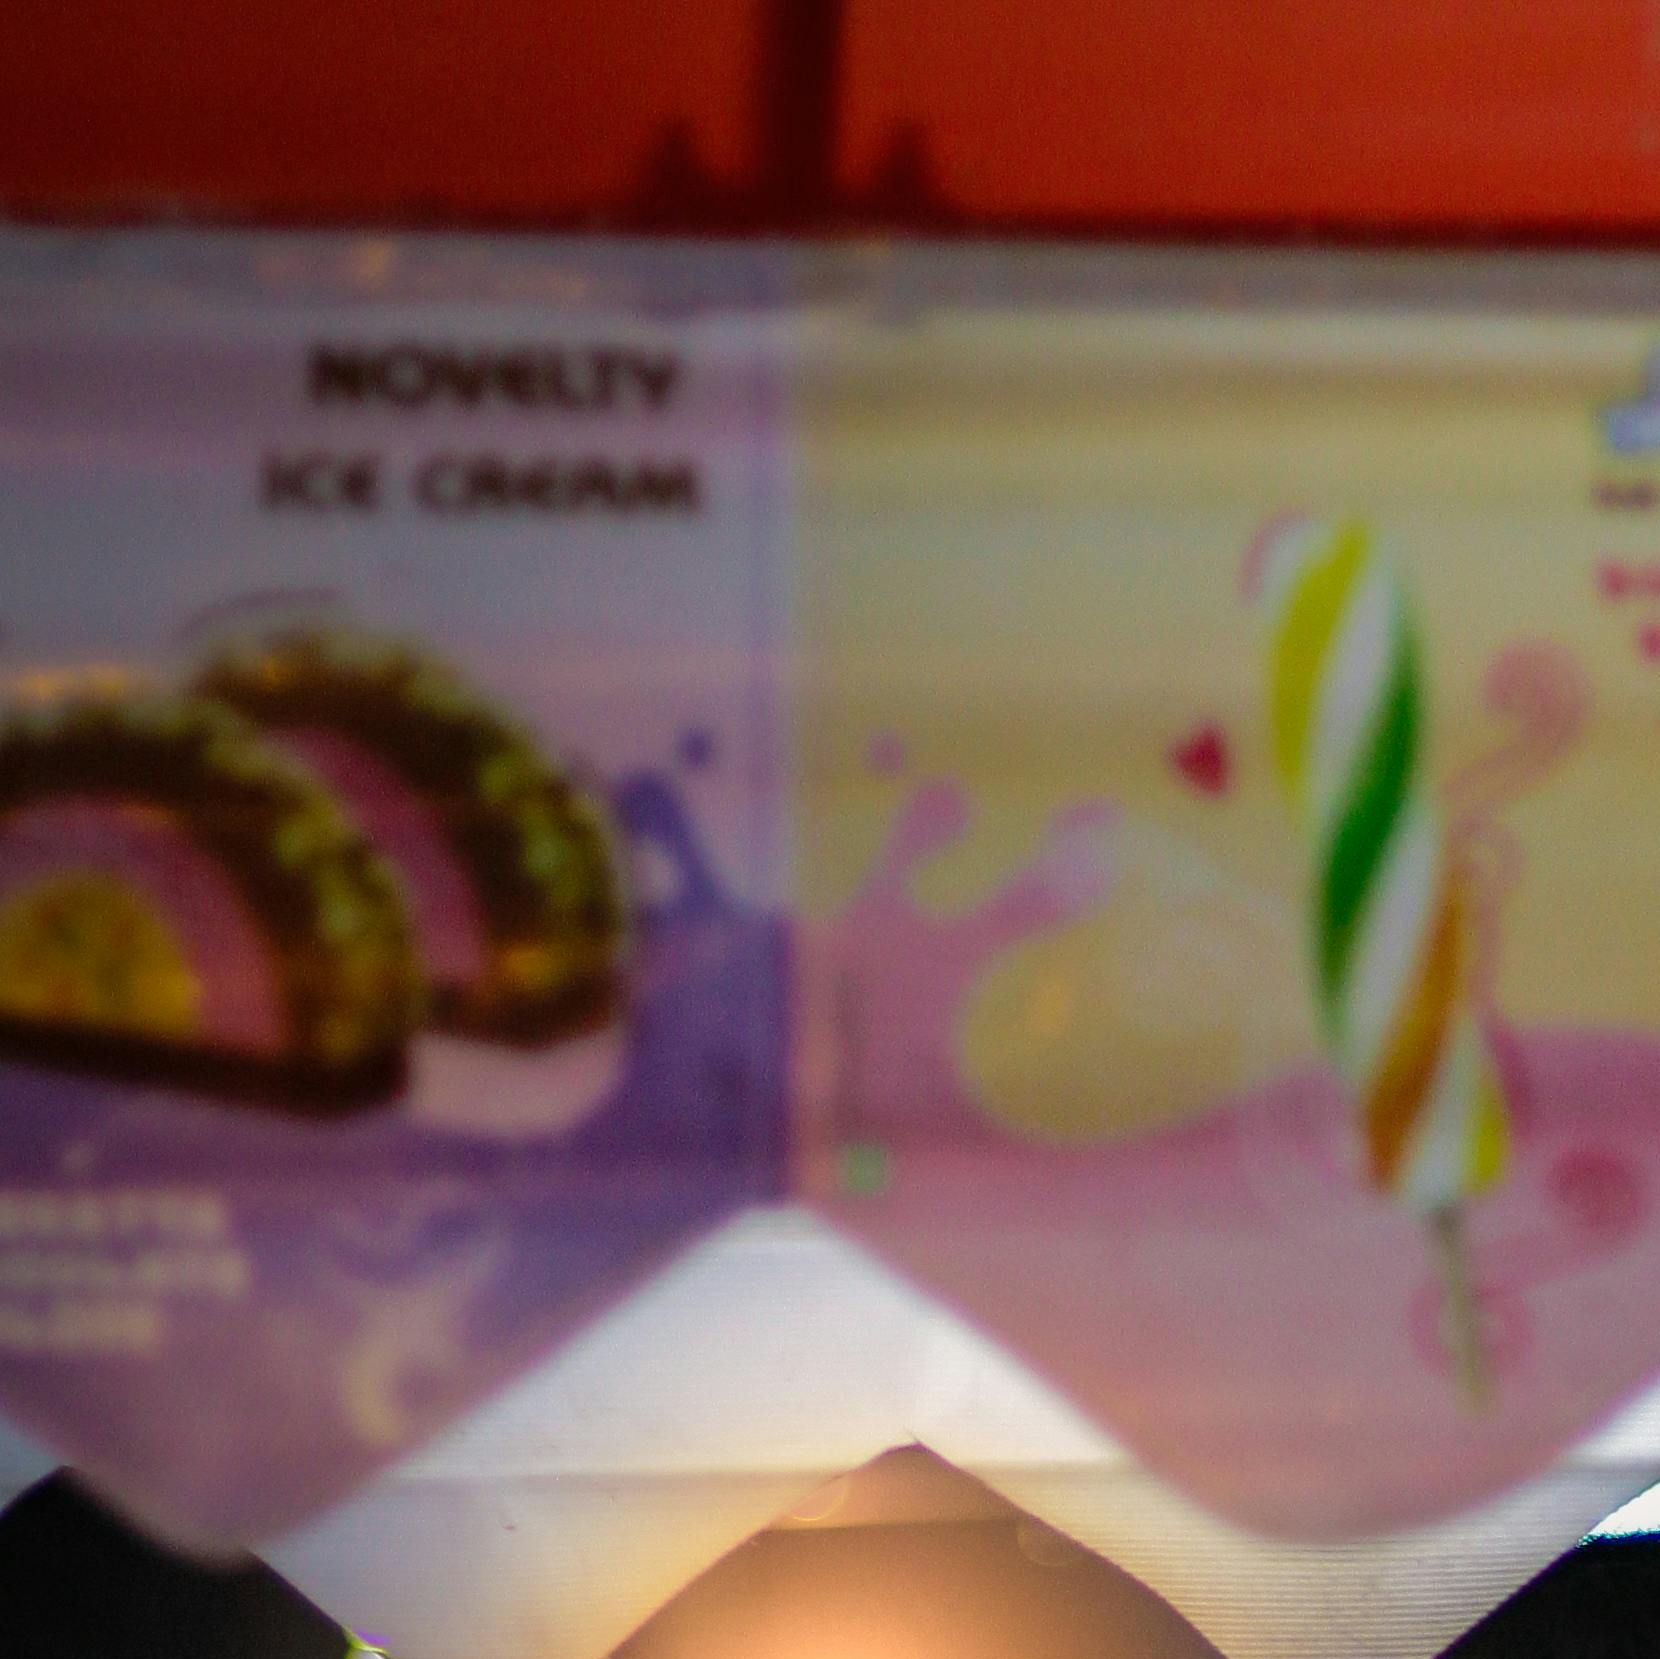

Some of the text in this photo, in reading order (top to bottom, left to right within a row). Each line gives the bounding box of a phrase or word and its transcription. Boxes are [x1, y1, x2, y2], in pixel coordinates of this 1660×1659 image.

[307, 344, 682, 404] NOVELTY
[260, 452, 703, 517] ICE CREAM
